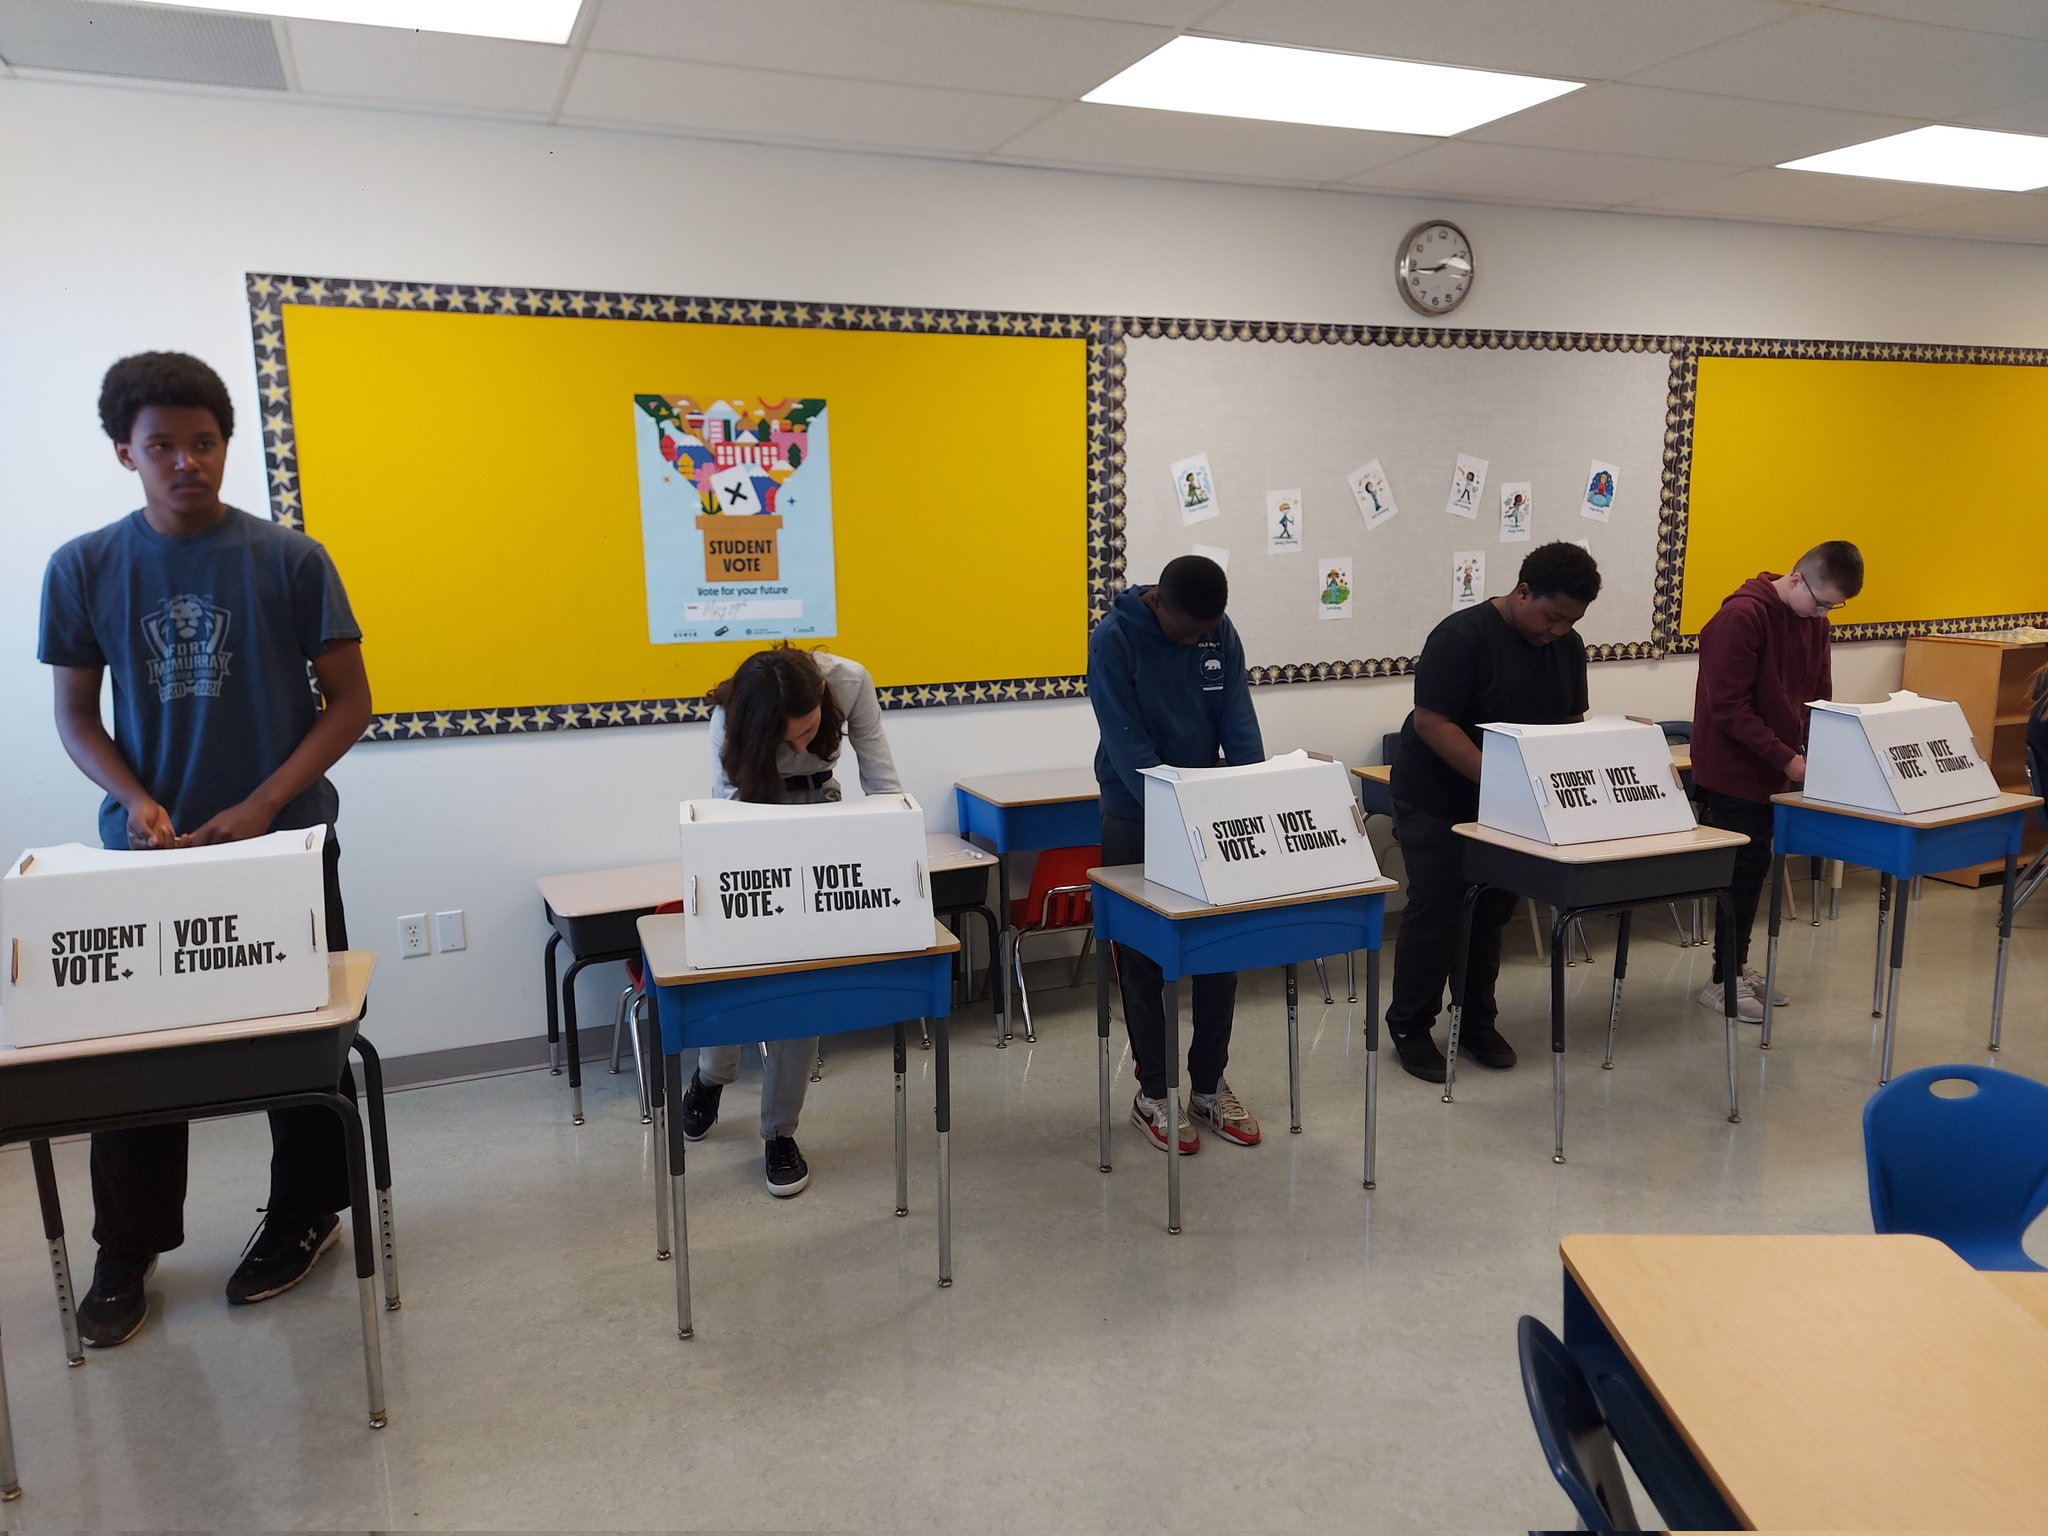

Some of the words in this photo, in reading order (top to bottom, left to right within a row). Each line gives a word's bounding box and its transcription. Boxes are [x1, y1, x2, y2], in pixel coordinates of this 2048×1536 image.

[709, 539, 772, 555] STUDENT
[723, 557, 761, 573] VOTE
[697, 586, 719, 597] Vote
[721, 586, 735, 596] for
[736, 586, 758, 597] your
[759, 585, 788, 595] future
[167, 640, 207, 657] FORT
[1888, 743, 1923, 761] STUDENT
[1926, 739, 1953, 758] VOTE
[1895, 759, 1924, 779] VOTE
[1935, 755, 1971, 773] ÉTUDIANT
[1550, 769, 1596, 789] STUDENT
[1605, 766, 1640, 787] VOTE
[1555, 787, 1592, 809] VOTE
[1612, 784, 1661, 804] ÉTUDIANT
[1212, 815, 1267, 840] STUDENT
[1277, 809, 1317, 834] VOTE
[1217, 836, 1260, 863] VOTE
[1284, 829, 1341, 853] ÉTUDIANT
[719, 867, 792, 893] STUDENT
[812, 863, 863, 890] VOTE
[720, 890, 773, 919] VOTE
[815, 887, 892, 913] ÉTUDIANT
[51, 923, 147, 956] STUDENT
[173, 914, 239, 947] VOTE
[174, 941, 276, 974] ÉTUDIANT
[52, 951, 119, 988] VOTE
